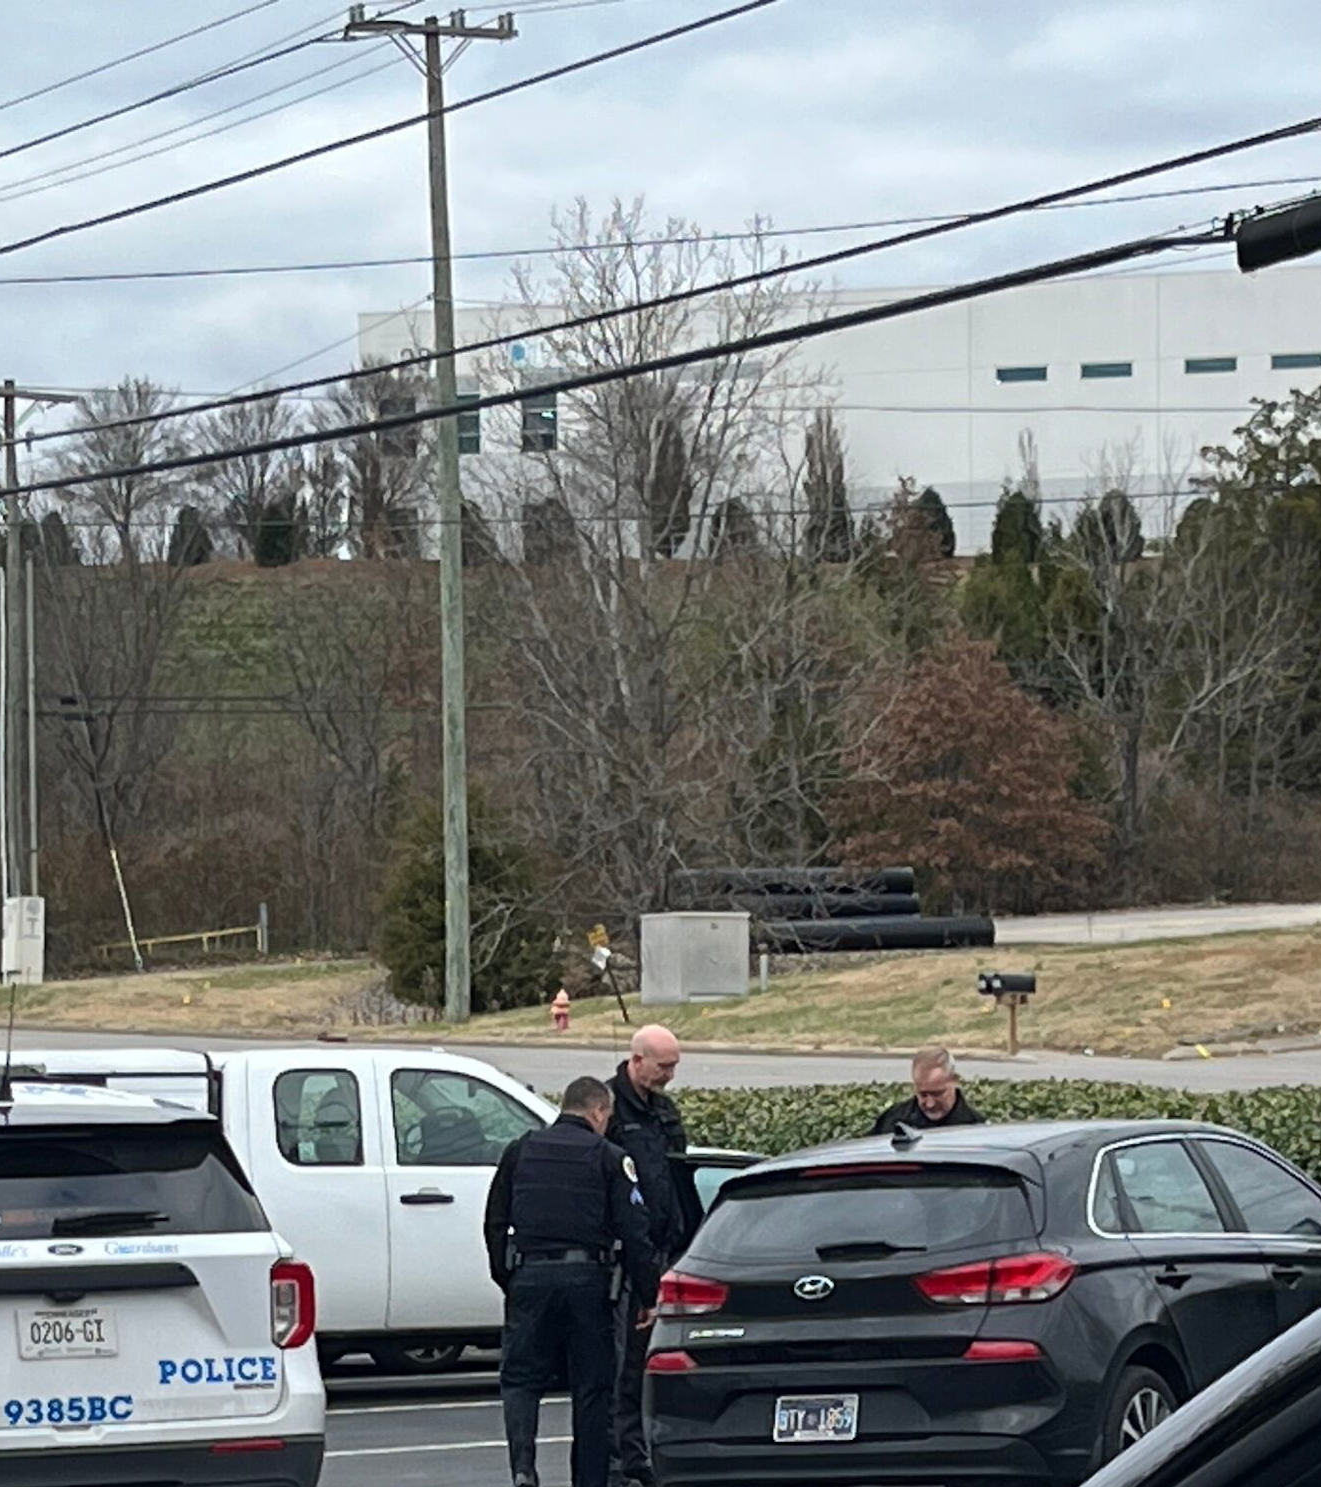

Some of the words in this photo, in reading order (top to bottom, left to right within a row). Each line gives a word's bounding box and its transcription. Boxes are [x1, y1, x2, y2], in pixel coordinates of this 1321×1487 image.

[30, 1318, 105, 1344] 0206-GI
[158, 1357, 277, 1385] POLICE
[4, 1396, 134, 1425] 9385BC
